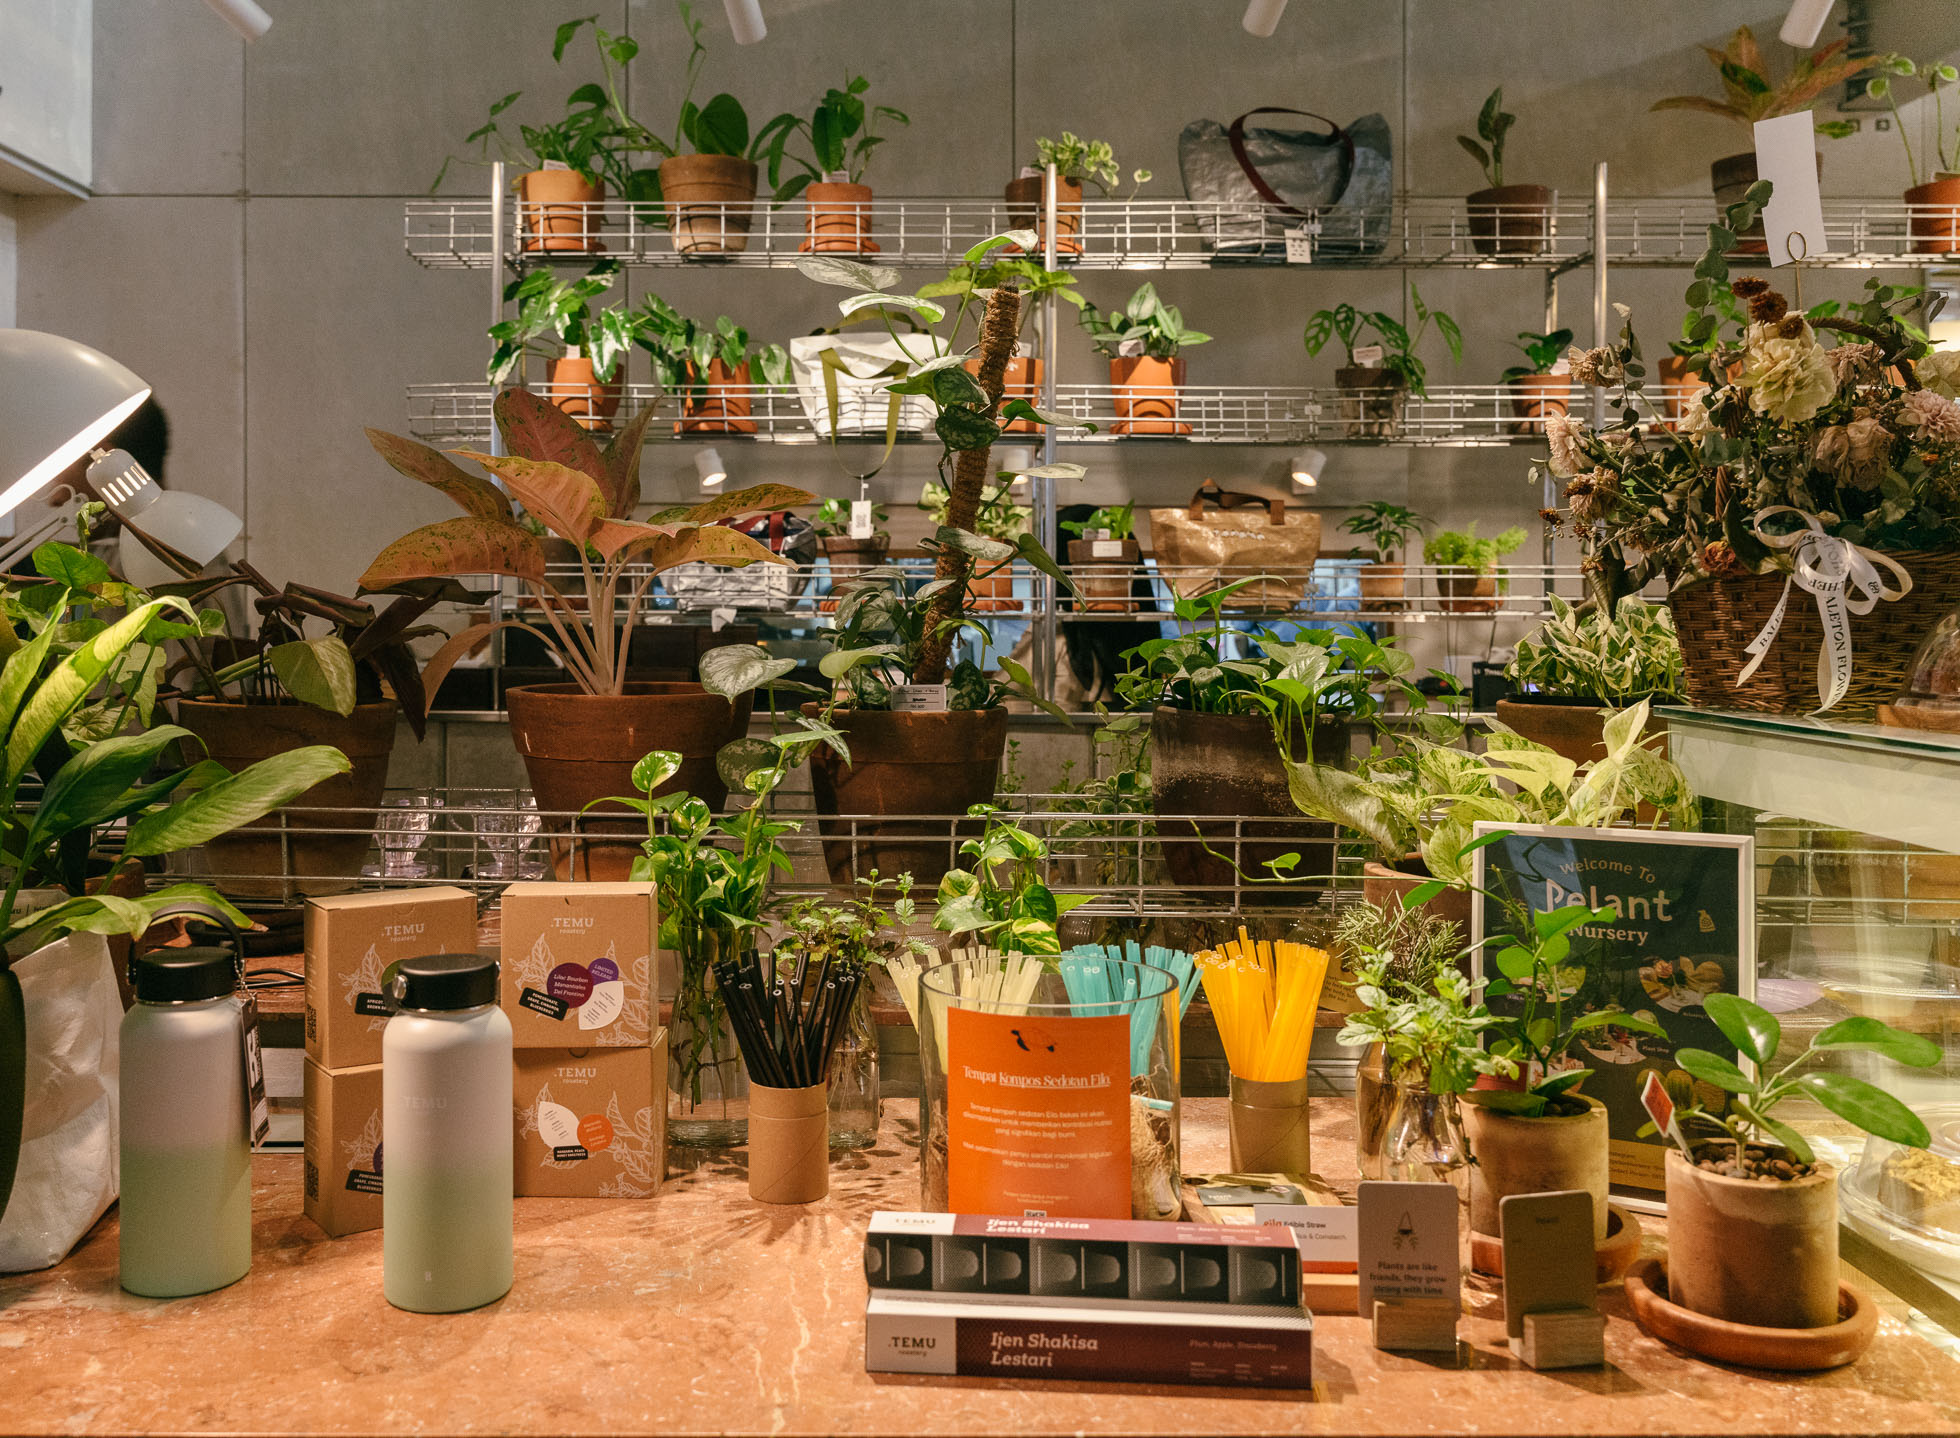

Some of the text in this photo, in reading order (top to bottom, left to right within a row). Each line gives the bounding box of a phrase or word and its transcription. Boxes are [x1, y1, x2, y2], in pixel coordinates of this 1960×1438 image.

[1560, 858, 1656, 884] Welcome To
[1546, 878, 1673, 922] Pelant
[1568, 926, 1649, 947] Nursery
[567, 975, 589, 984] Bourbon
[962, 1065, 997, 1084] Tempat
[999, 1071, 1042, 1088] Kompos
[1043, 1073, 1088, 1087] Sedotan
[1306, 1220, 1327, 1230] Straw
[1377, 1260, 1439, 1271] Plants are like
[1402, 1286, 1422, 1294] with
[990, 1331, 1099, 1351] Ijen Shakisa
[990, 1351, 1053, 1367] Lestari
